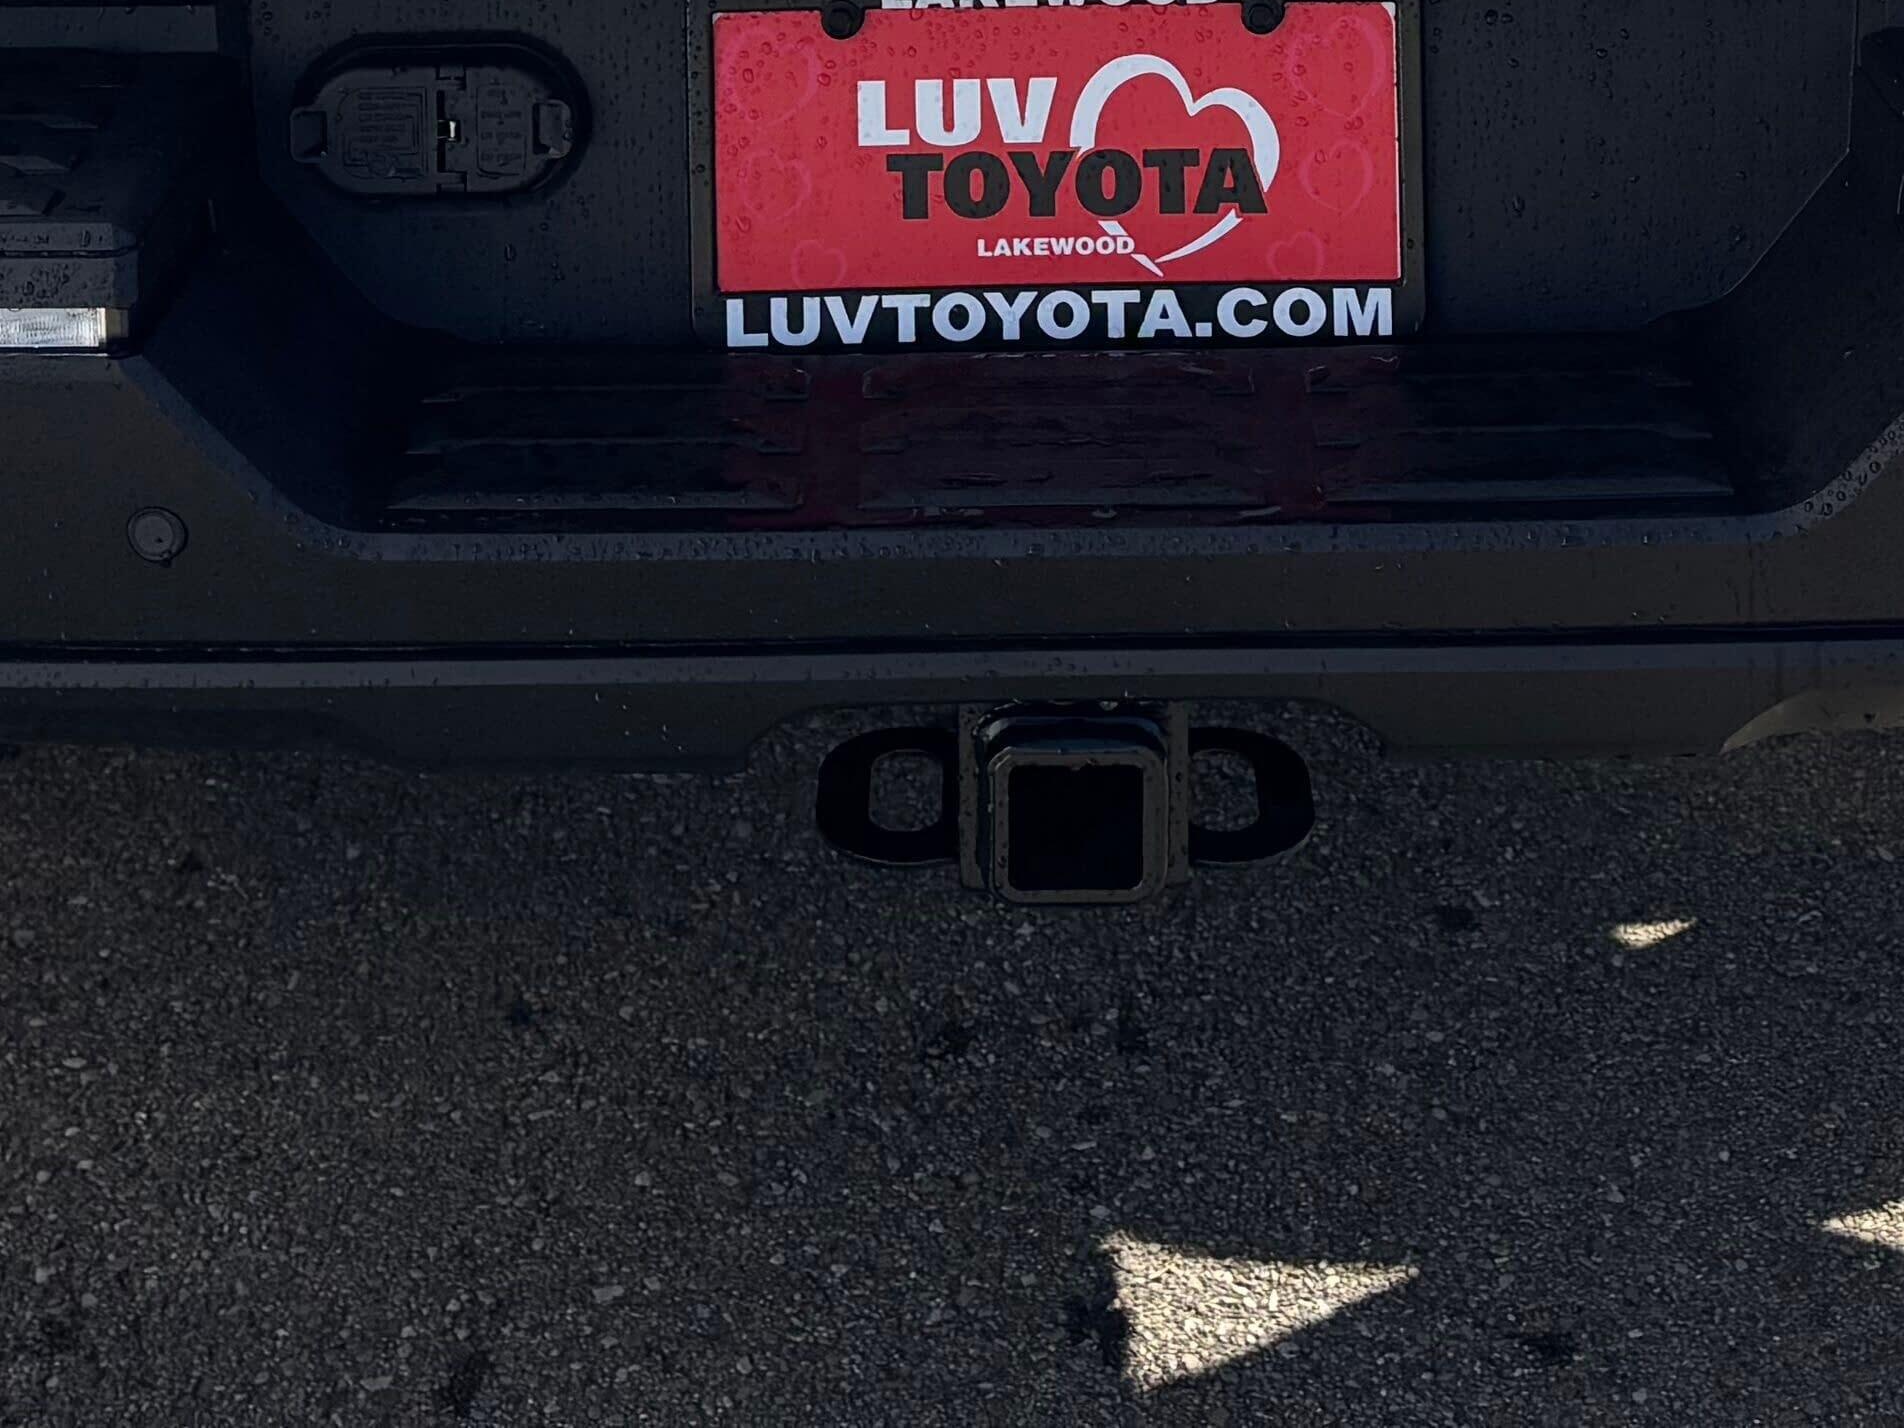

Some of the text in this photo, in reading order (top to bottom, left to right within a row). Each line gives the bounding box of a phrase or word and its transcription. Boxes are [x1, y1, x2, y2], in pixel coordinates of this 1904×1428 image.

[857, 76, 1057, 148] LUV
[886, 147, 1269, 220] TOYOTA
[976, 234, 1136, 258] LAKEWOOD
[725, 287, 1395, 348] LUVTOYOTA.COM
